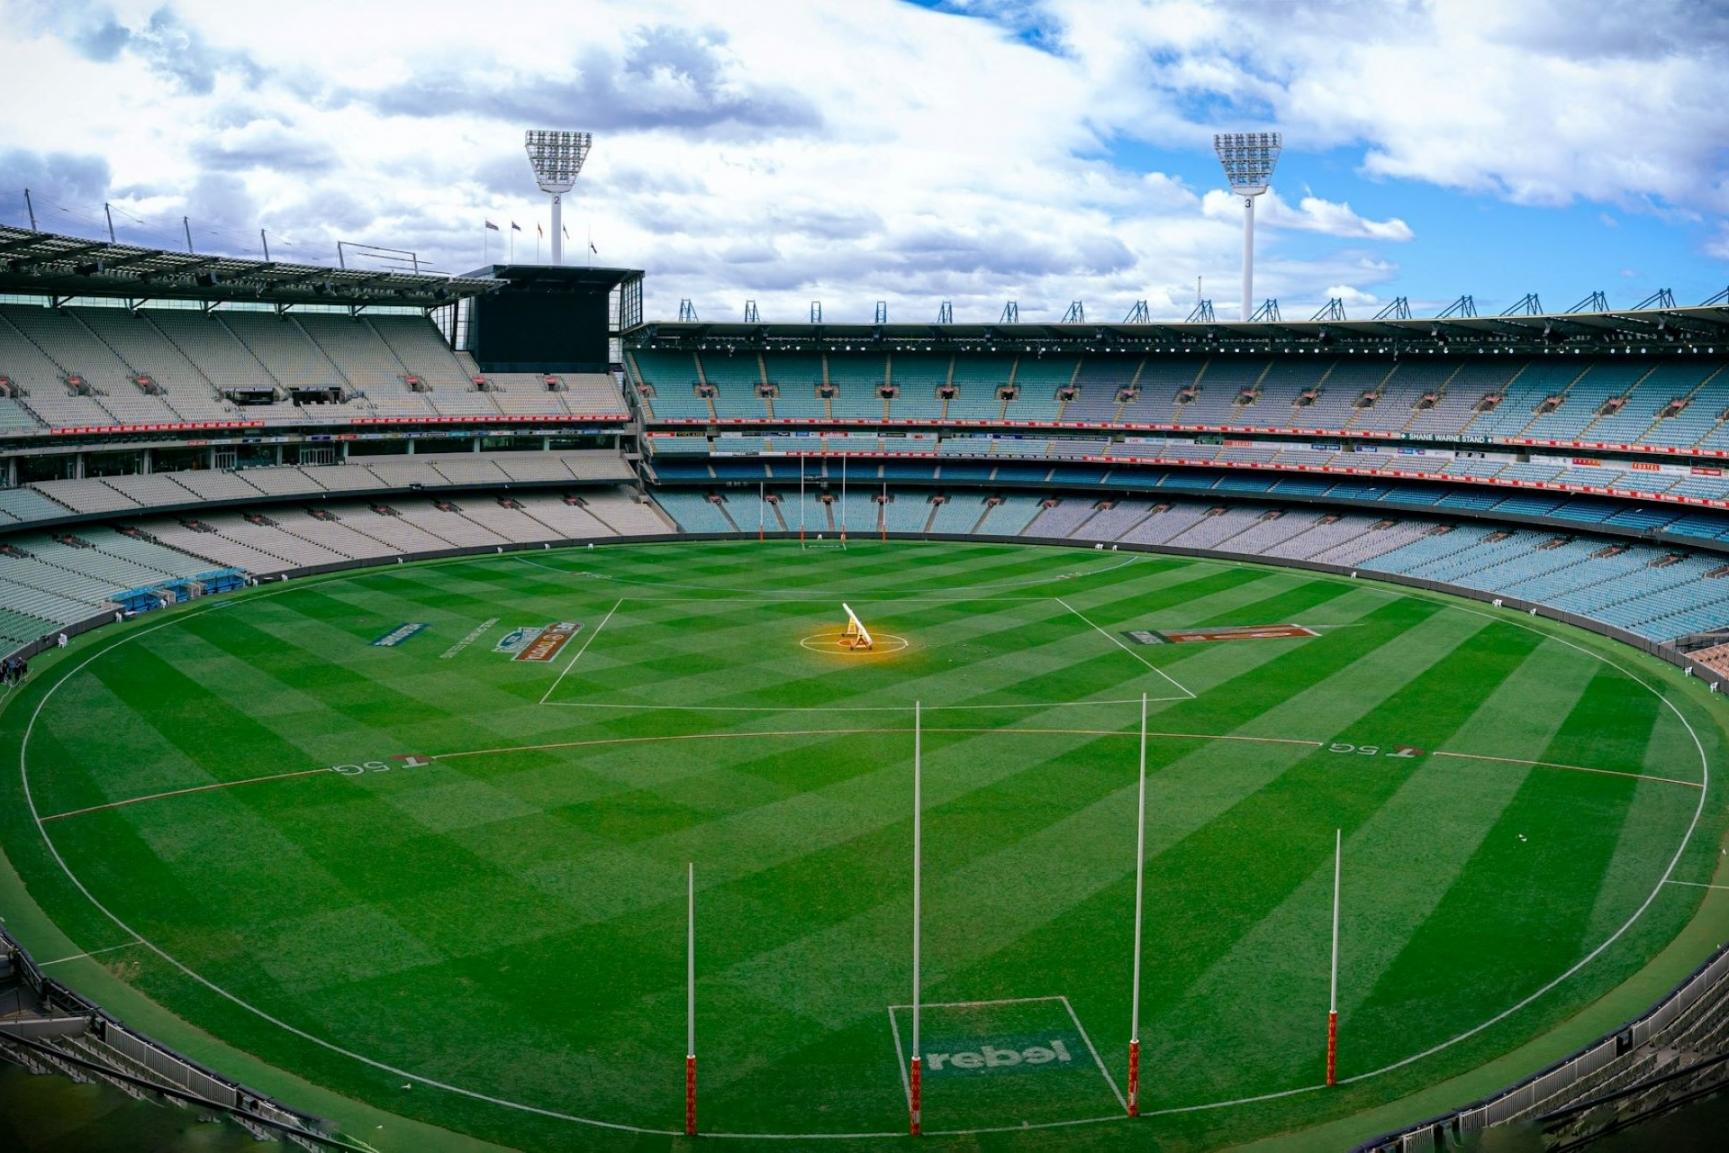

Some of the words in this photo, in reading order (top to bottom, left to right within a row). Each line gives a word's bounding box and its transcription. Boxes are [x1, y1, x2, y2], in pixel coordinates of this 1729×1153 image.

[554, 196, 560, 205] 2
[1245, 198, 1251, 208] 3
[1409, 433, 1433, 441] SHANE
[1435, 434, 1460, 443] WARNE
[1462, 435, 1485, 443] STAND
[1328, 743, 1379, 756] 5G
[333, 761, 390, 776] 5G
[926, 1040, 1072, 1071] rebel
